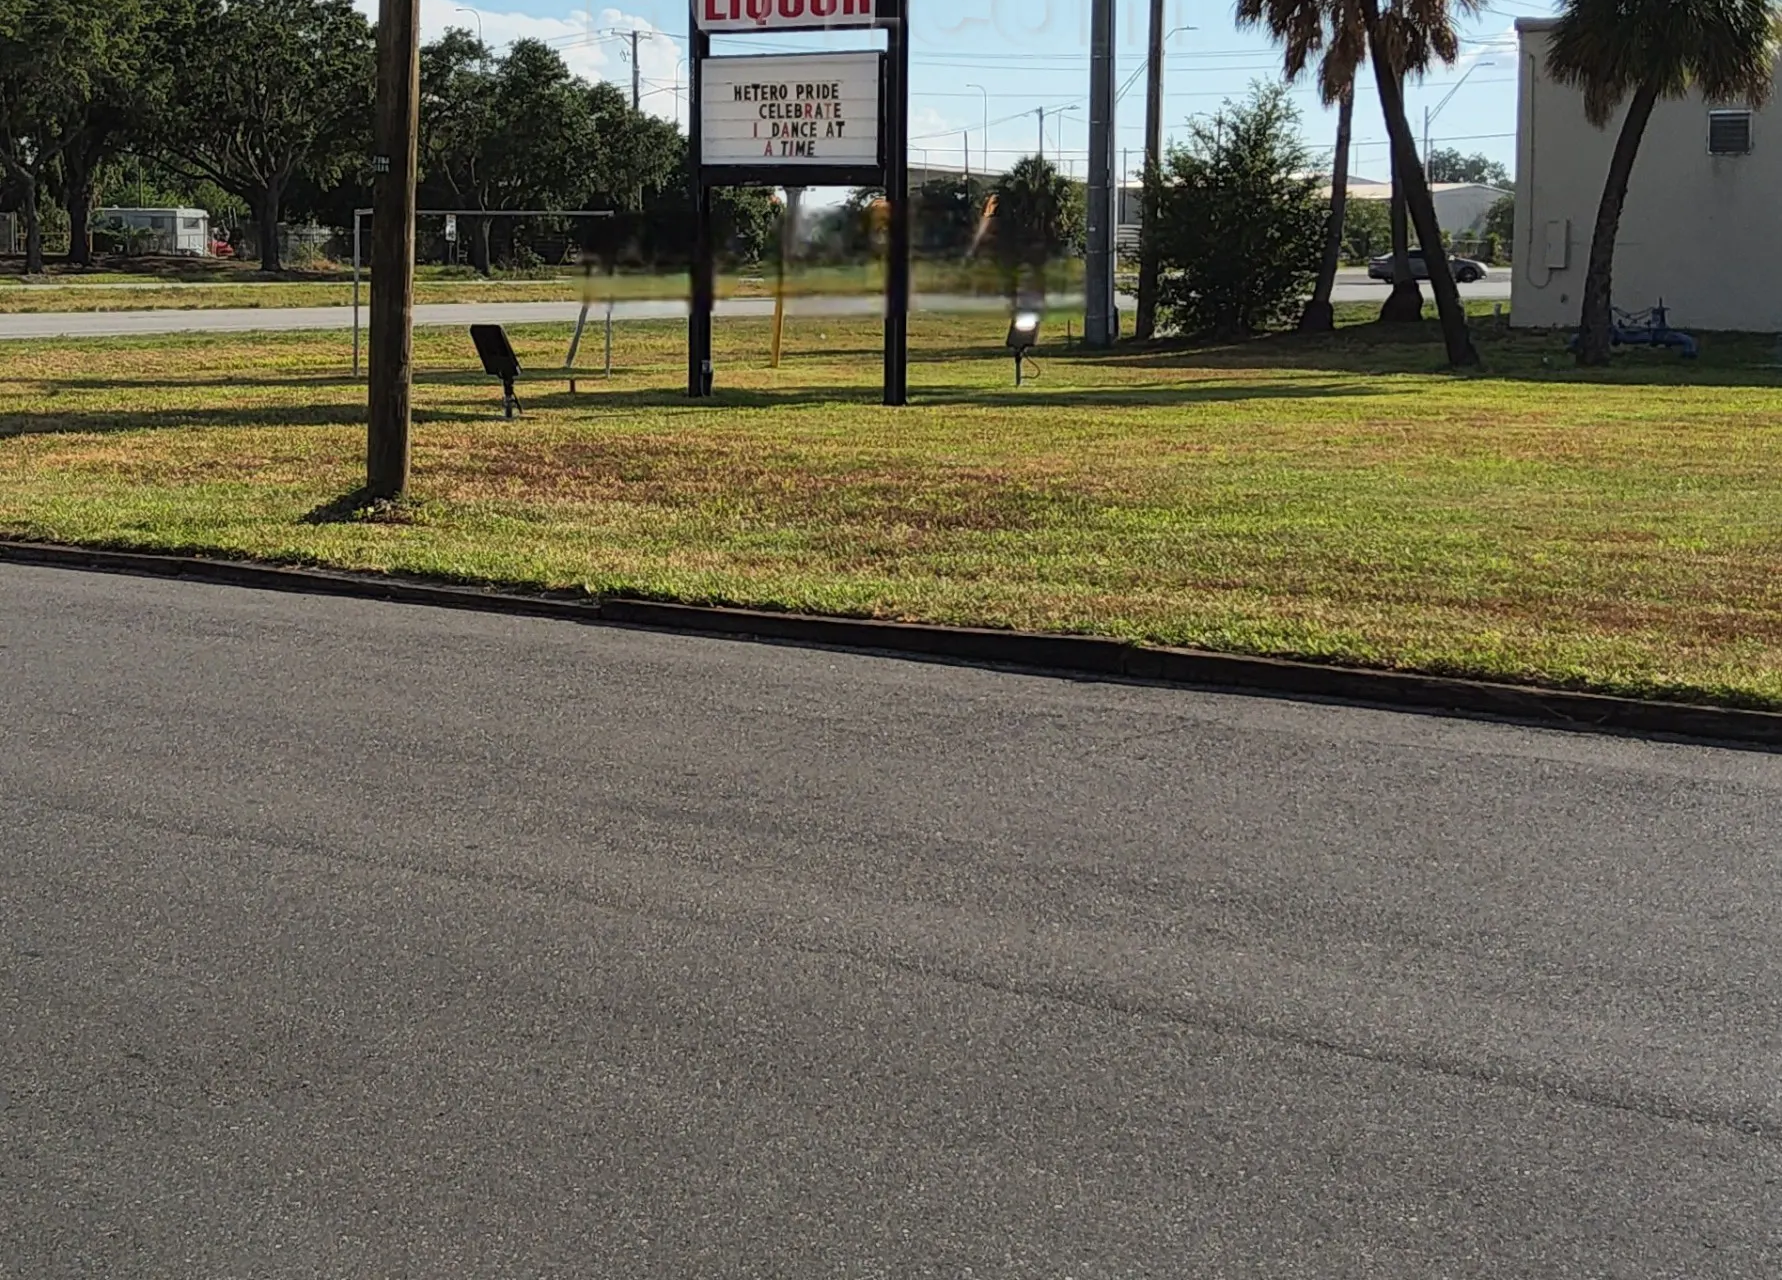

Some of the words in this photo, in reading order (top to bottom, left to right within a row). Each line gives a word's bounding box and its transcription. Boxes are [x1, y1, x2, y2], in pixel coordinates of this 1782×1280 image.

[734, 83, 788, 101] HETERO
[796, 82, 840, 100] PRIDE
[759, 102, 842, 120] CELEBRATE
[752, 122, 758, 138] I
[771, 121, 818, 138] DANCE
[826, 121, 845, 138] AT
[764, 141, 773, 156] A
[781, 140, 816, 157] TIME
